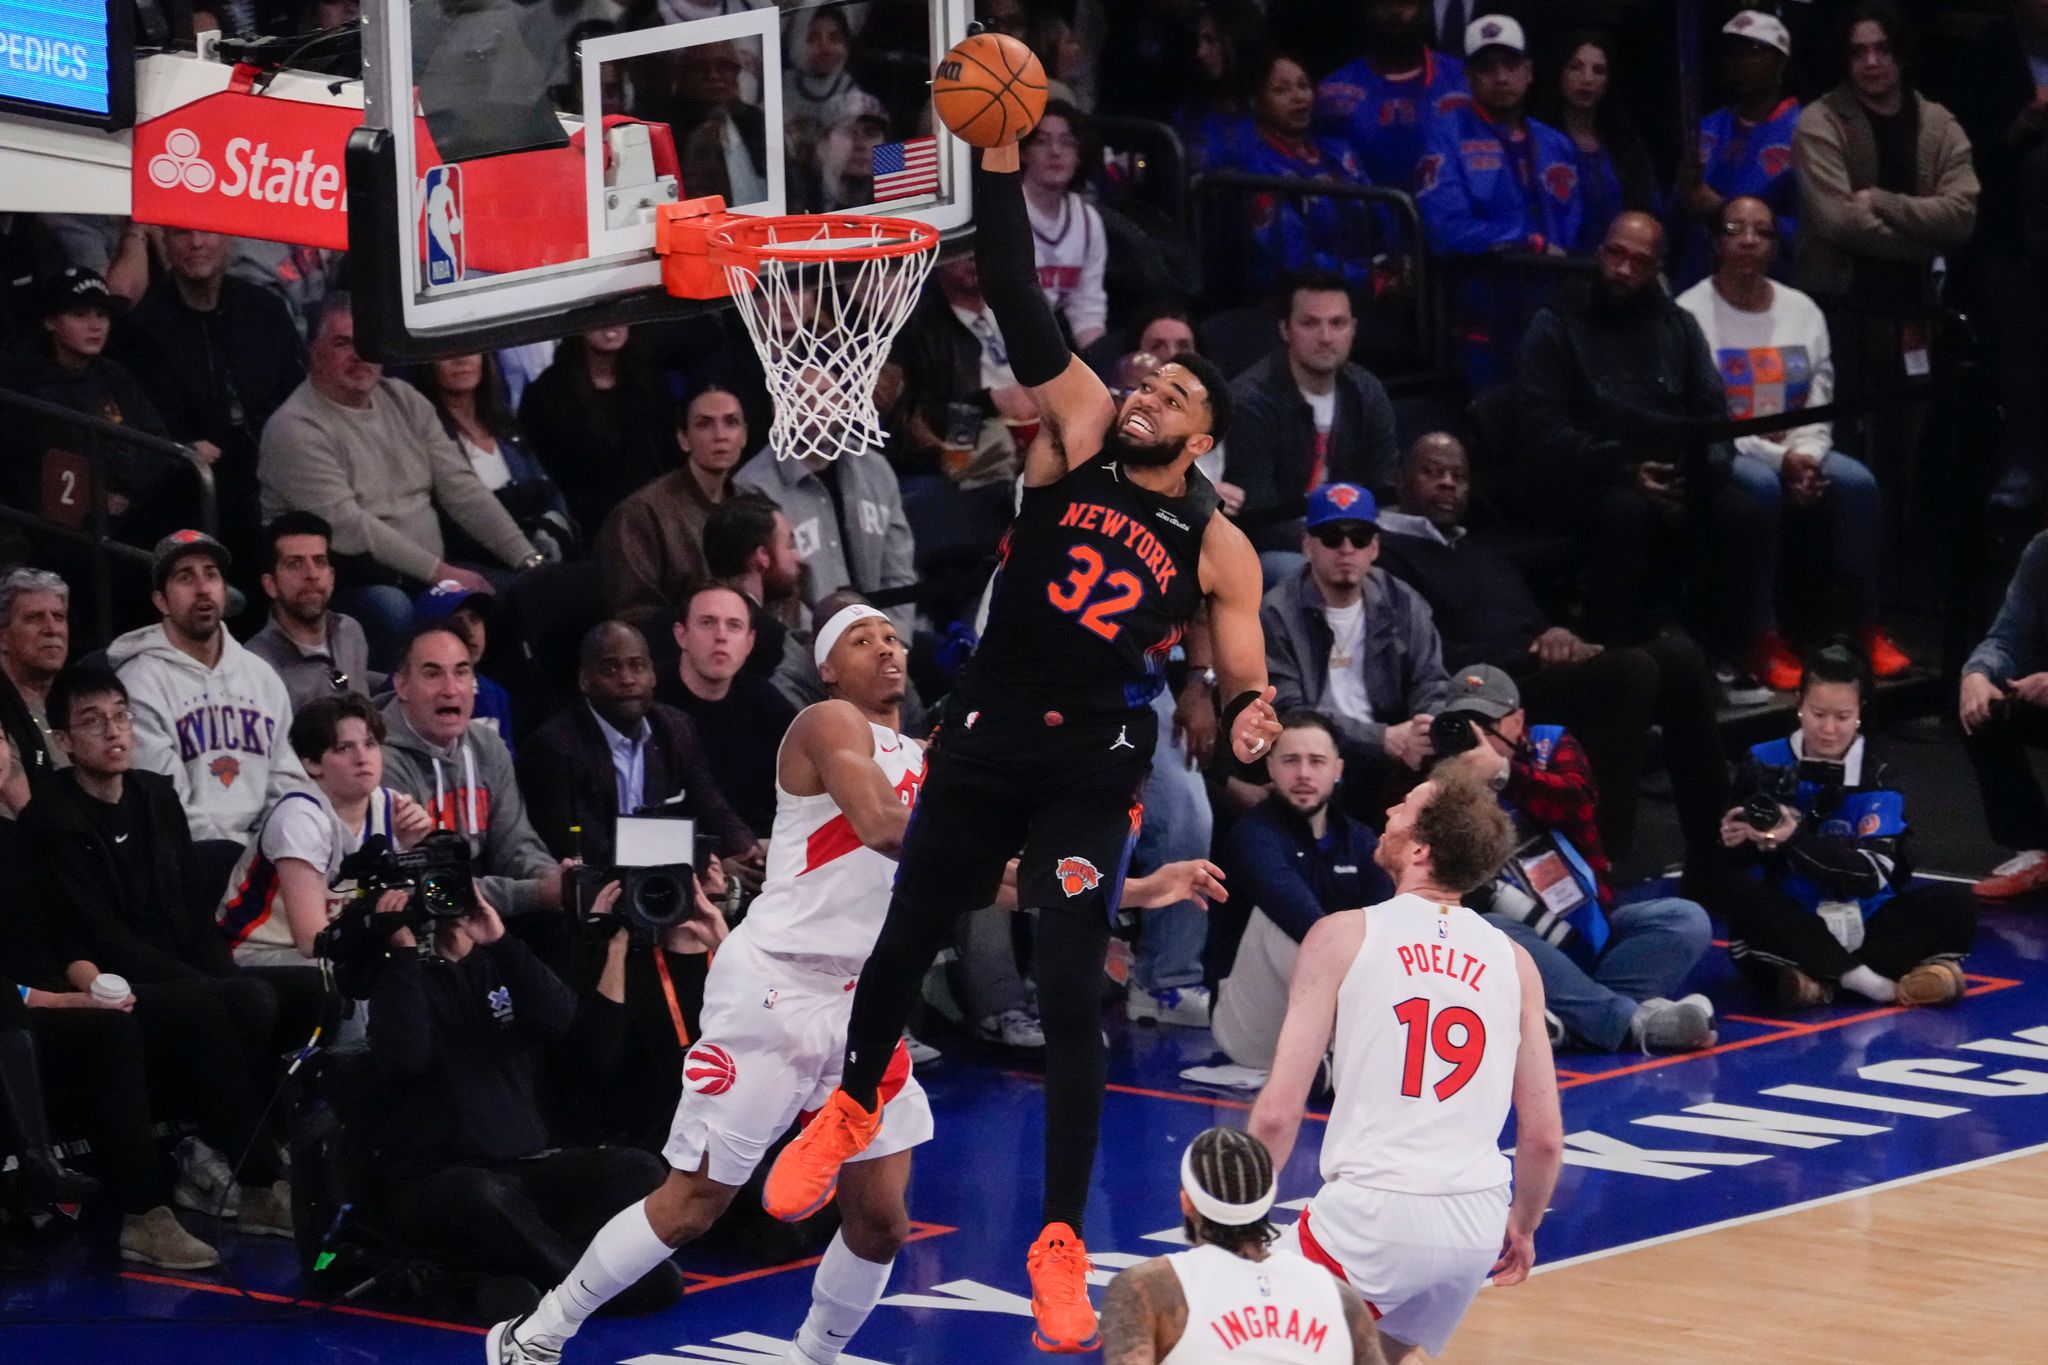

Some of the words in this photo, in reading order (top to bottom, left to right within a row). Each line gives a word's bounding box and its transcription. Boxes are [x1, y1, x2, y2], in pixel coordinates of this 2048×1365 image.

[219, 137, 340, 210] State
[61, 470, 76, 505] 2
[1047, 543, 1145, 642] 32
[1397, 943, 1487, 992] POELTL
[1393, 997, 1487, 1103] 19
[1210, 1304, 1328, 1354] INGRAM
